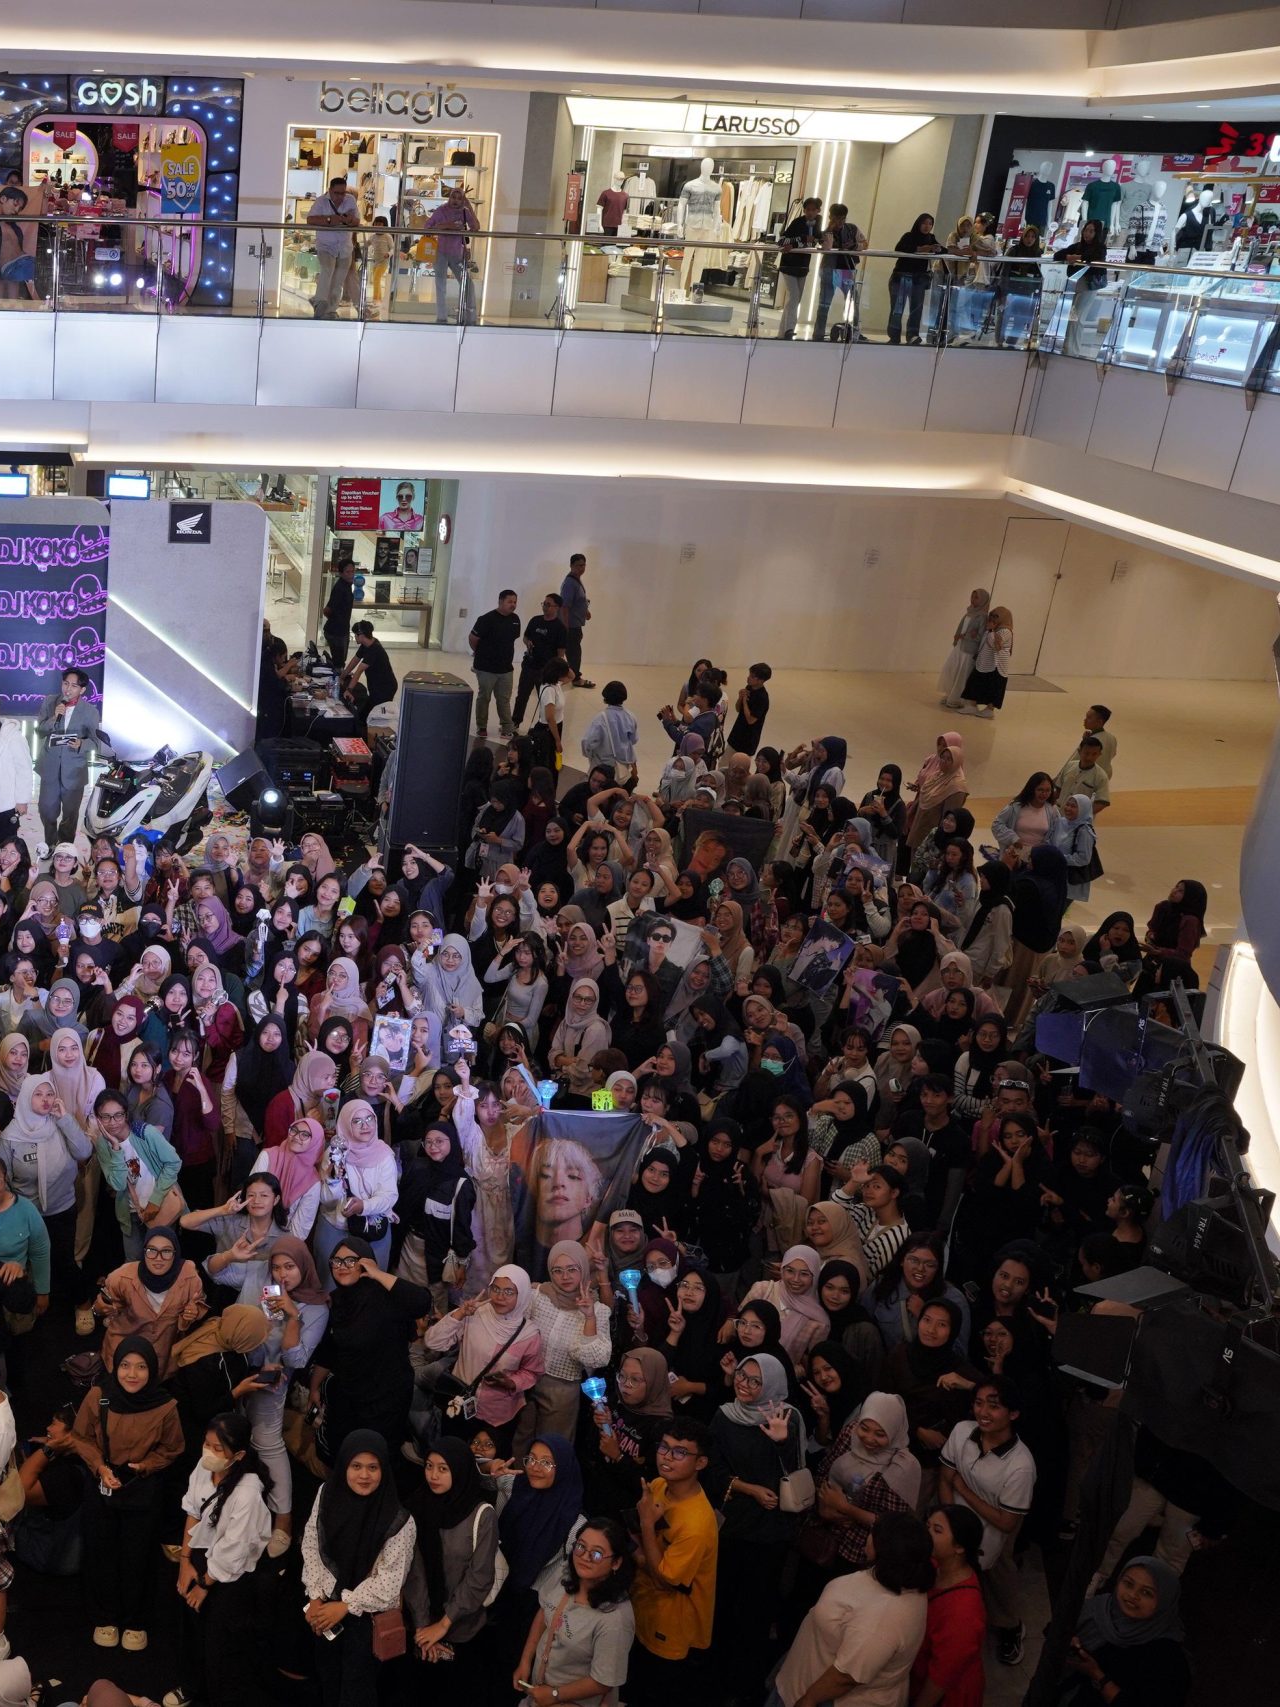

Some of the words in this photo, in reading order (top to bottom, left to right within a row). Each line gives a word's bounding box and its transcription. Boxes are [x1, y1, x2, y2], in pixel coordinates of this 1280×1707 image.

[320, 81, 468, 124] bellagio
[55, 131, 75, 139] SALE
[702, 114, 801, 136] LARUSSO
[168, 162, 195, 175] SALE
[23, 538, 81, 567] KOKO
[22, 591, 79, 620] KOKO
[20, 643, 78, 671] KOKO
[1198, 1216, 1208, 1234] TRF
